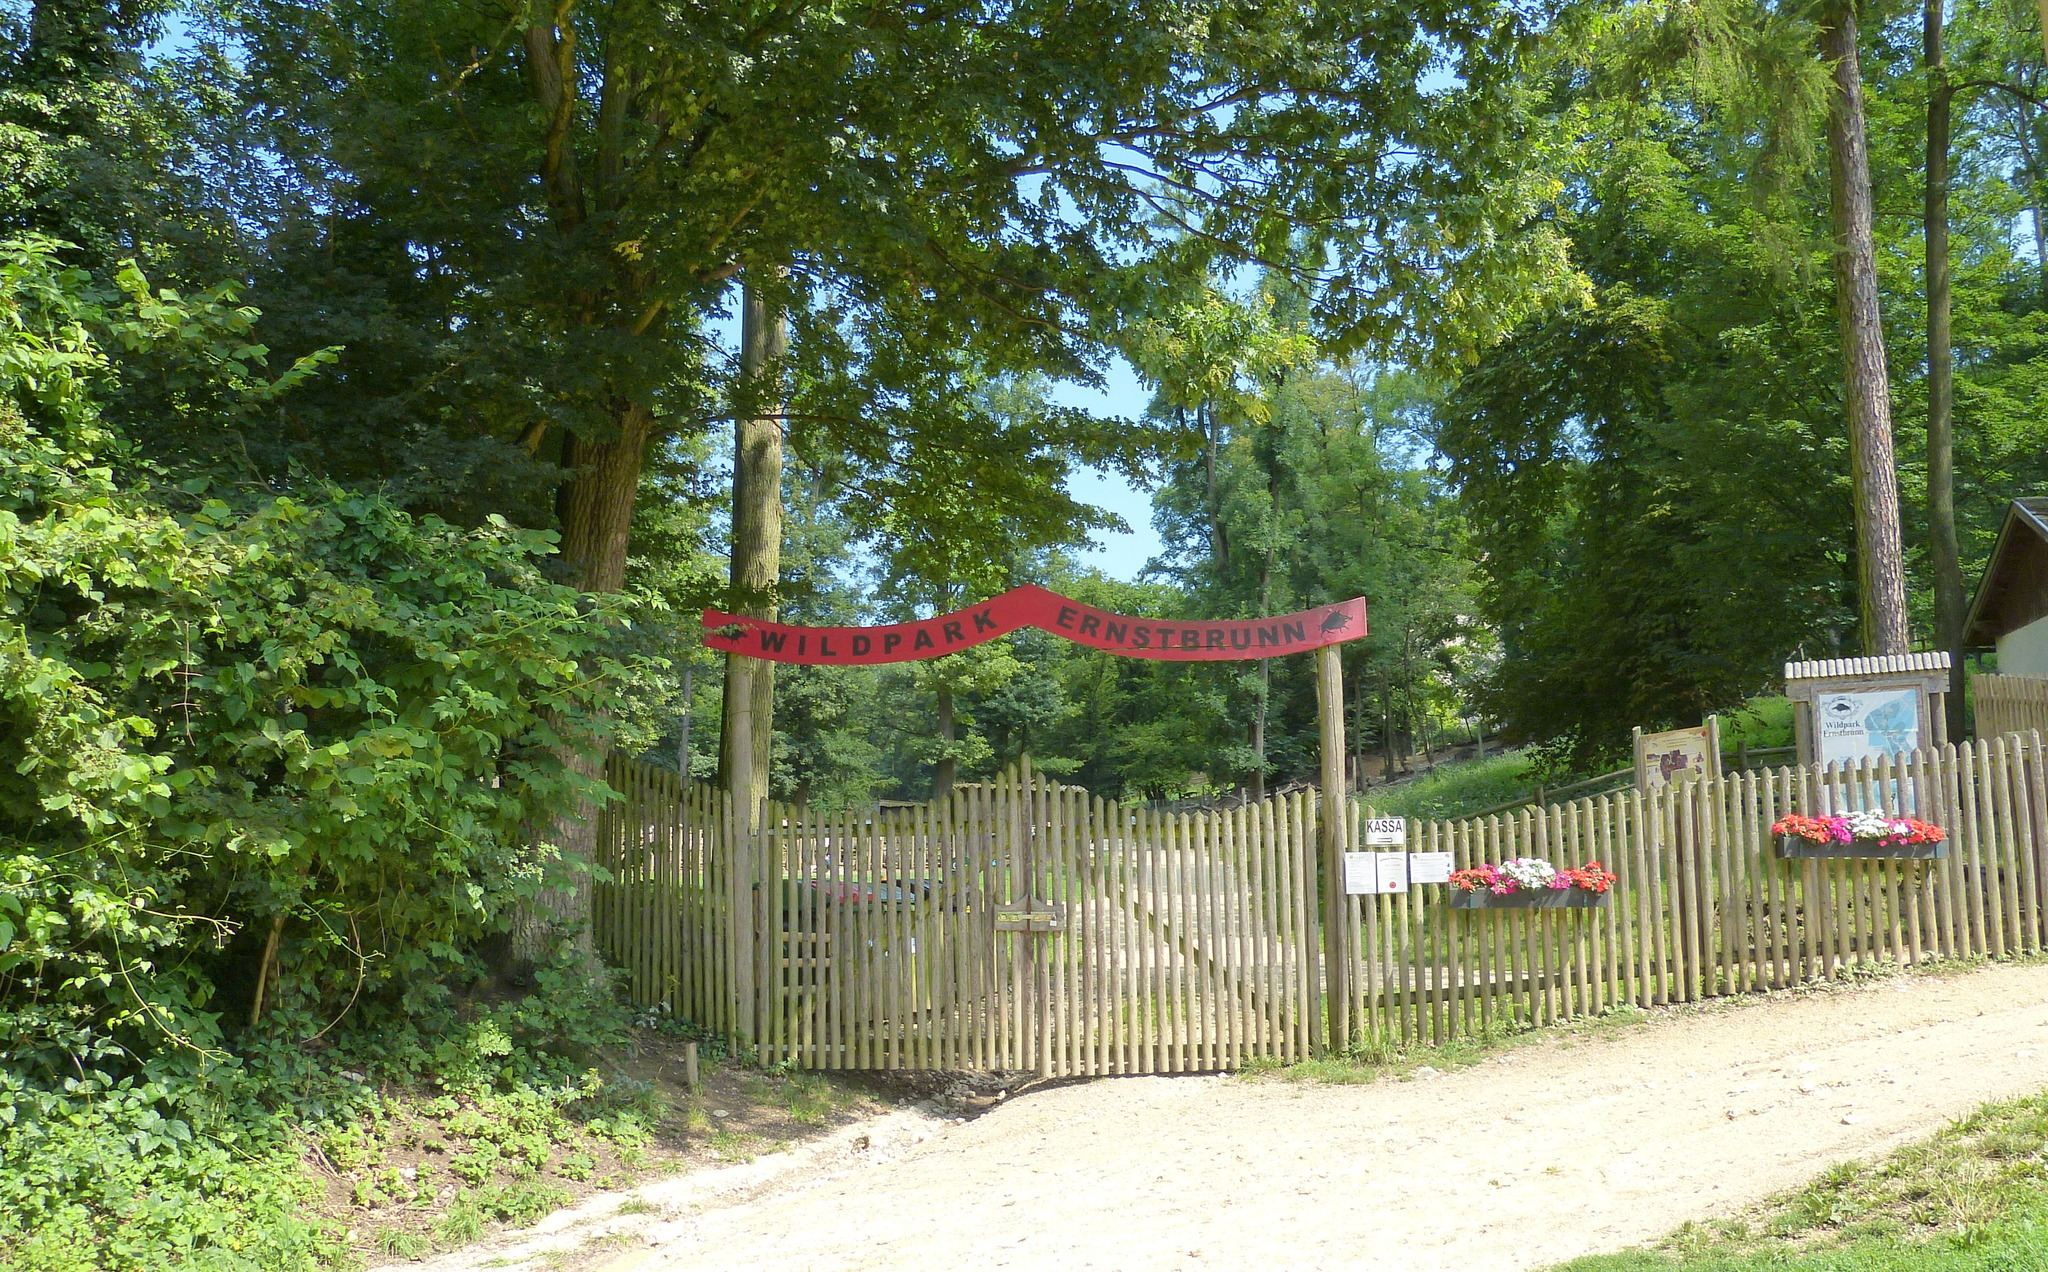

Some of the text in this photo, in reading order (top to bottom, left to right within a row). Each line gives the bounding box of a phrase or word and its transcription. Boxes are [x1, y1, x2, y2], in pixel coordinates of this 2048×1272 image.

[760, 606, 1306, 656] WILDPARK ERNSTBRUNN
[1825, 720, 1861, 729] Wildpark
[1823, 729, 1864, 737] Ernstbrunn
[1366, 820, 1403, 834] KASSA
